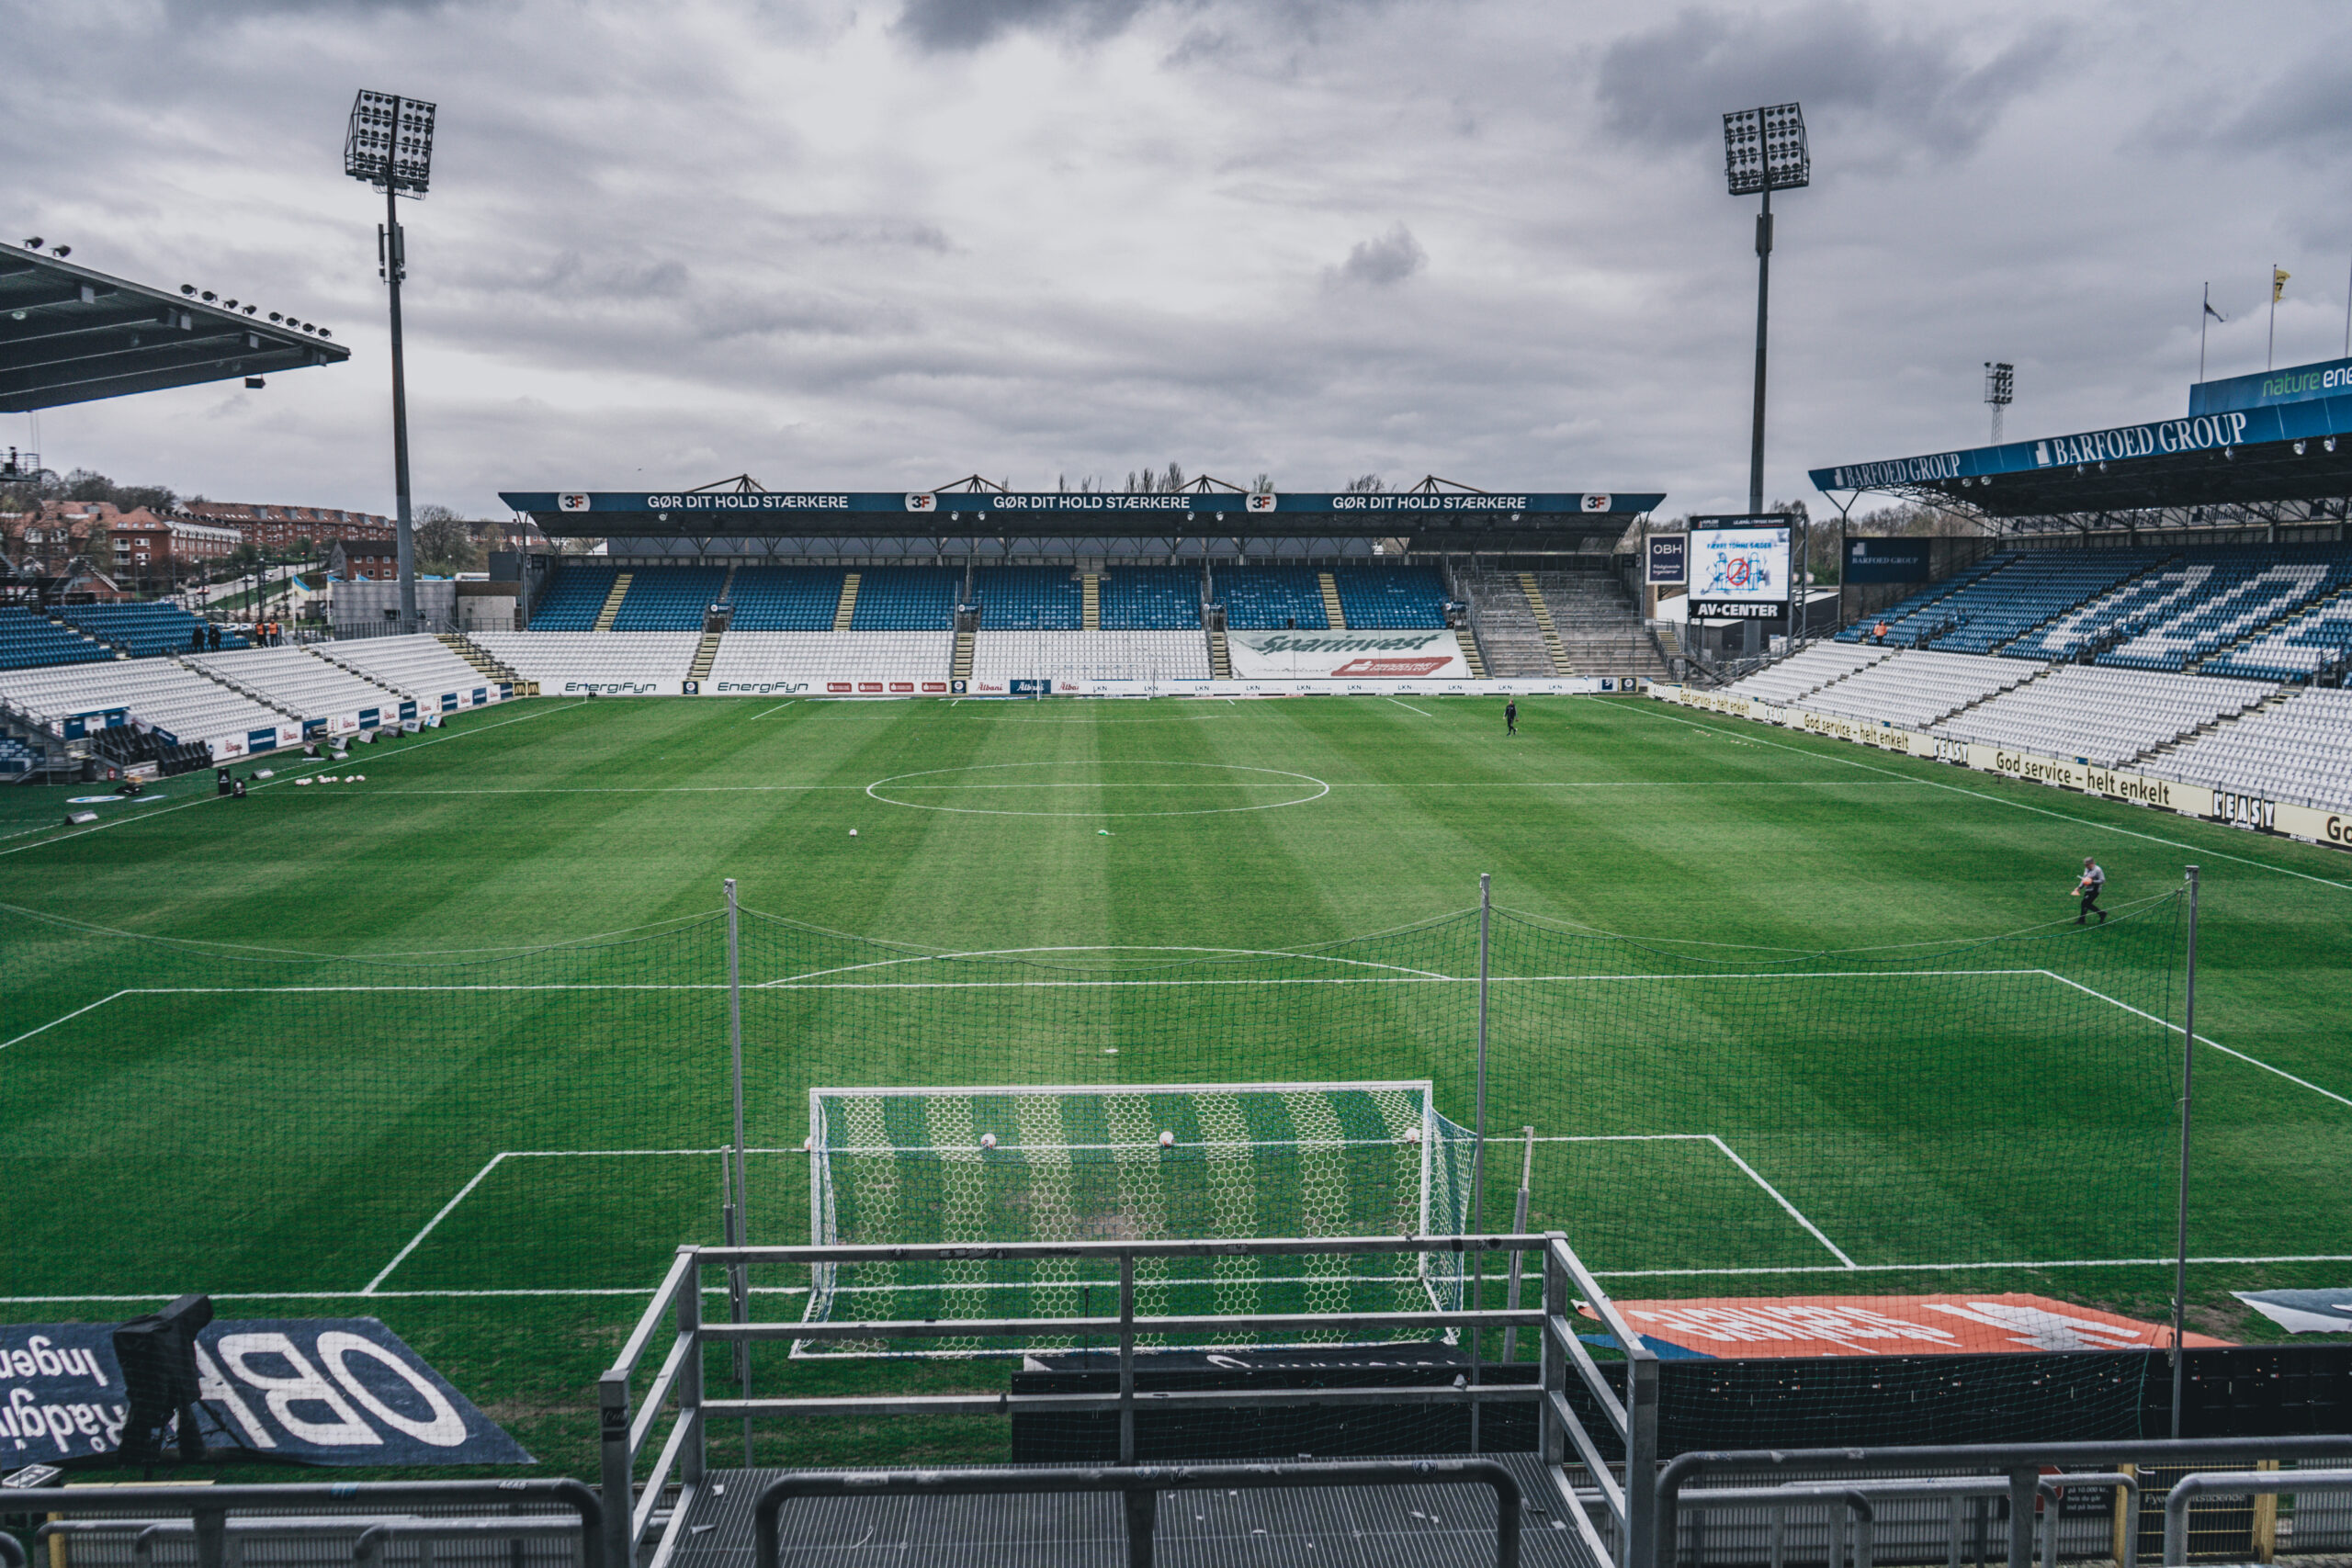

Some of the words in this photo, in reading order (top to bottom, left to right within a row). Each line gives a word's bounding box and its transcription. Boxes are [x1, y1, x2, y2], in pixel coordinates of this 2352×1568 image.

[2263, 372, 2321, 397] nature
[2052, 426, 2154, 465] BARFOED
[2159, 412, 2246, 453] GROUP
[1845, 460, 1906, 487] BARFOED
[1908, 454, 1960, 481] GROUP
[564, 495, 583, 509] 3F
[648, 495, 683, 509] GØR
[686, 495, 712, 509] DIT
[715, 495, 759, 509] HOLD
[763, 495, 849, 509] STÆRKERE
[910, 495, 930, 509] 3F
[993, 496, 1027, 509] GØR
[1032, 496, 1057, 509] DIT
[1059, 496, 1102, 509] HOLD
[1106, 496, 1190, 509] STÆRKERE
[1252, 495, 1271, 509] 3F
[1332, 496, 1366, 509] GØR
[1370, 496, 1395, 509] DIT
[1397, 496, 1441, 509] HOLD
[1443, 496, 1526, 509] STÆRKERE
[1587, 495, 1606, 509] 3F
[1654, 544, 1682, 554] OBH
[1804, 714, 1820, 729] God
[1822, 720, 1850, 737] service
[1860, 724, 1877, 743] helt
[1880, 731, 1909, 750] enkelt
[1996, 751, 2020, 773] God
[2025, 761, 2071, 784] service
[2087, 768, 2115, 793] helt
[2120, 778, 2170, 805] enkelt
